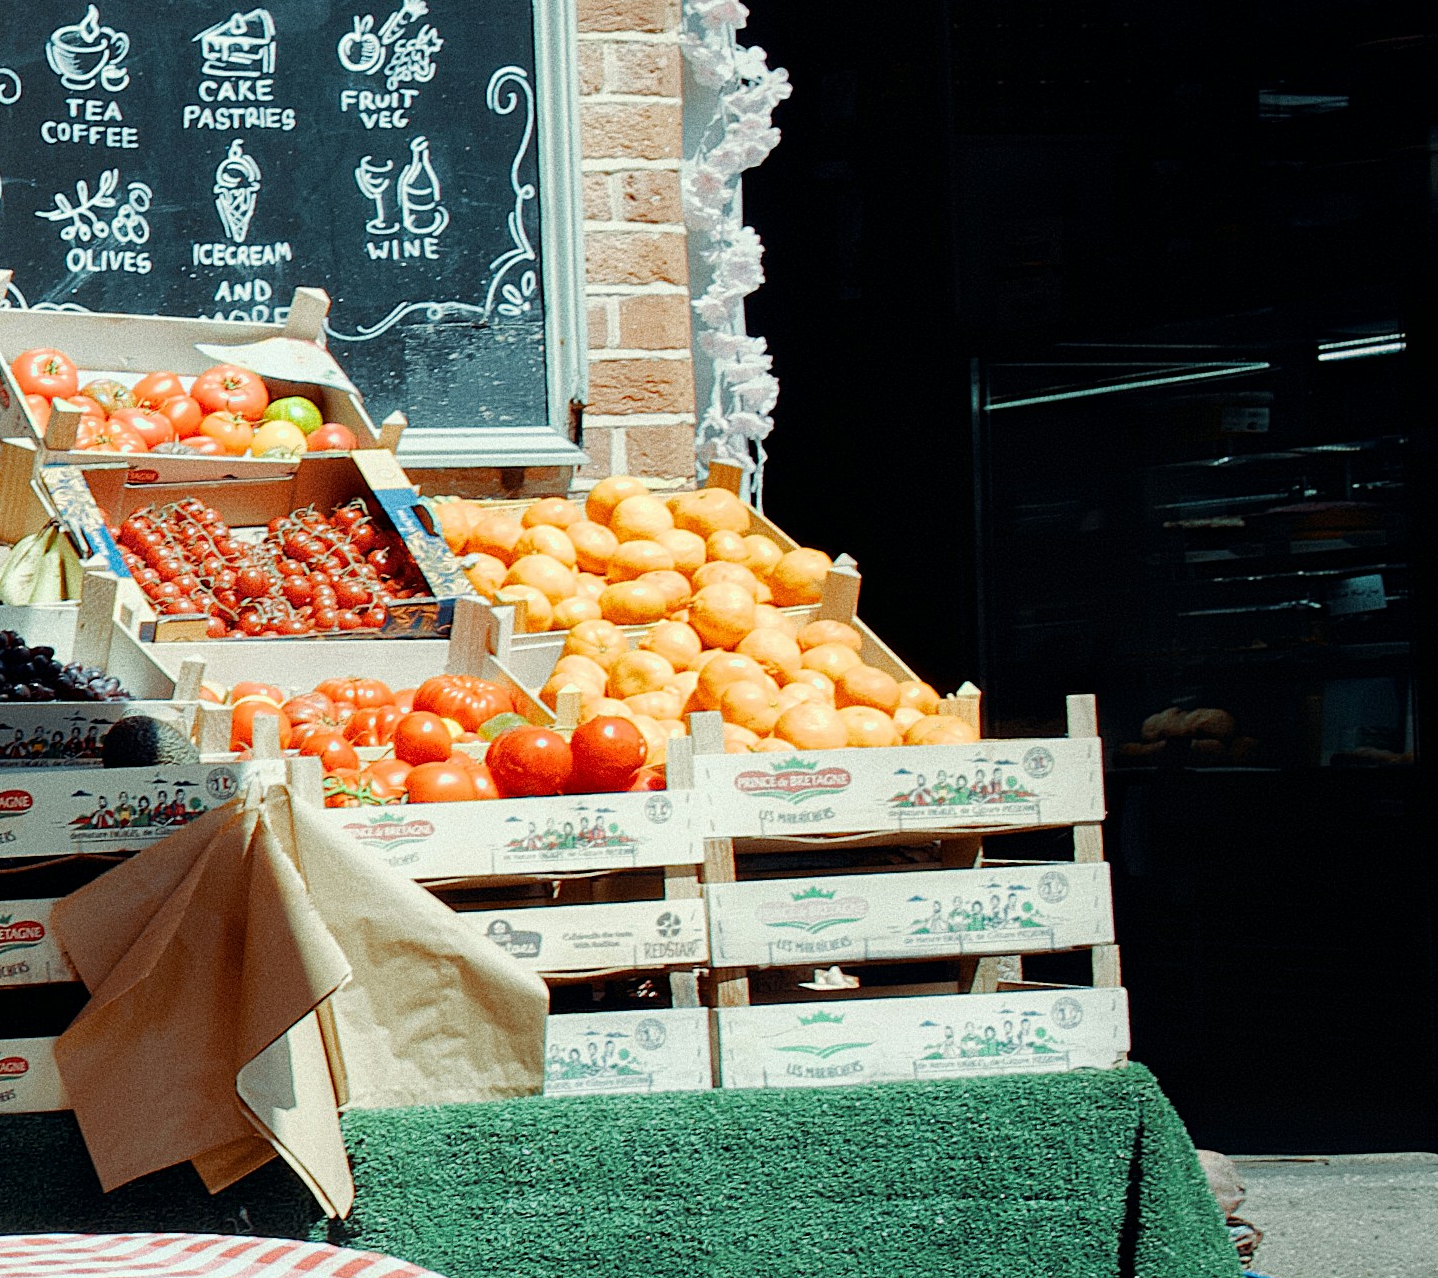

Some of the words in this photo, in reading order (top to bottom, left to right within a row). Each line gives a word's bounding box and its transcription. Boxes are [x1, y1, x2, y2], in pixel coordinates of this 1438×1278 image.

[198, 79, 275, 103] CAKE
[341, 89, 420, 114] FRUIT
[66, 98, 124, 122] TEA
[184, 105, 296, 132] PASTRIES
[360, 109, 410, 130] VEG
[42, 122, 140, 150] COFFEE
[66, 247, 153, 275] OLIVES
[366, 237, 440, 261] WINE
[214, 280, 272, 303] AND
[738, 777, 778, 790] PRINCE
[789, 772, 848, 788] BRETAGNE
